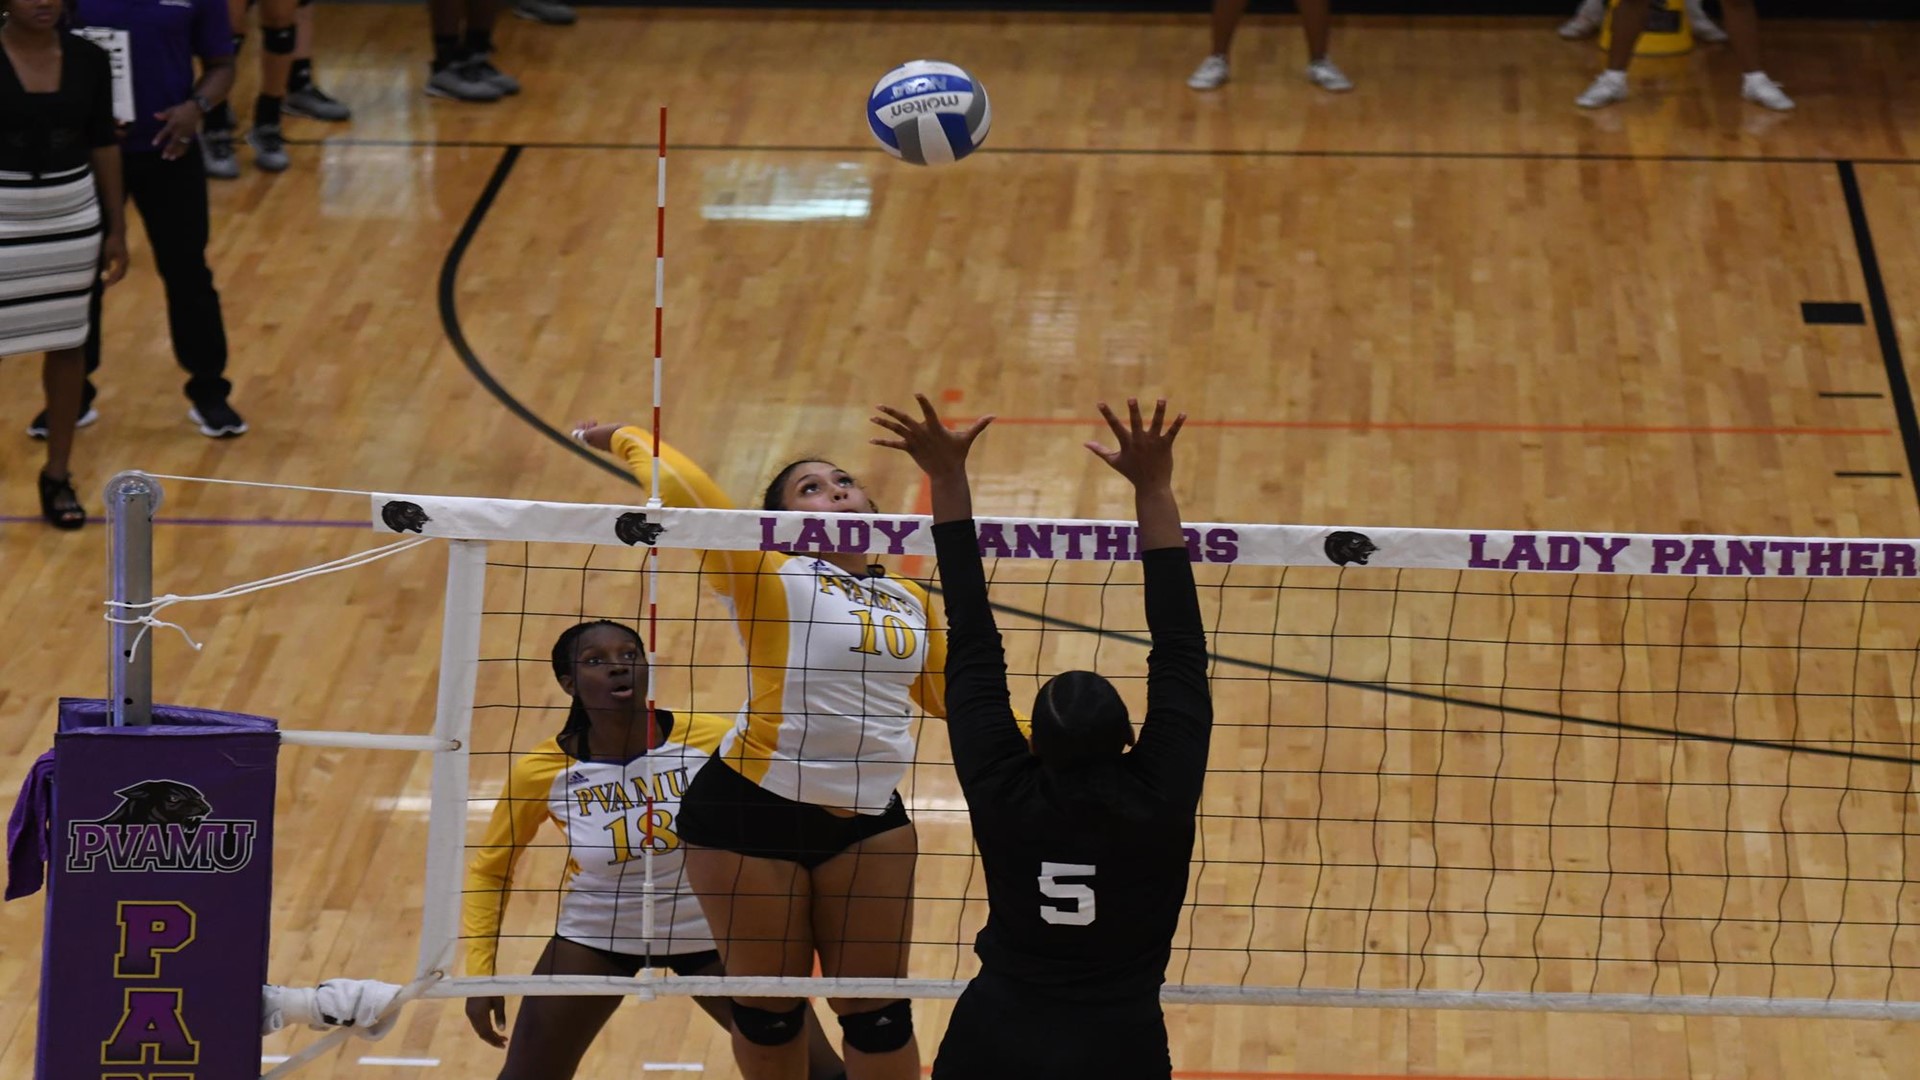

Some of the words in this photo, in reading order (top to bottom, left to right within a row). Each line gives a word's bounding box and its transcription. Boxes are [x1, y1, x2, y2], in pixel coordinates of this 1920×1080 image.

[890, 95, 959, 117] molten
[760, 517, 919, 555] LADY
[977, 523, 1239, 563] ANTHRS
[1468, 534, 1630, 572] LADY
[1651, 539, 1917, 577] PANTHER
[848, 609, 917, 660] 10
[574, 766, 689, 817] PVAMU
[66, 819, 257, 873] PVAMU
[603, 809, 681, 866] 18
[1037, 861, 1096, 926] 5
[100, 900, 200, 1080] PA
